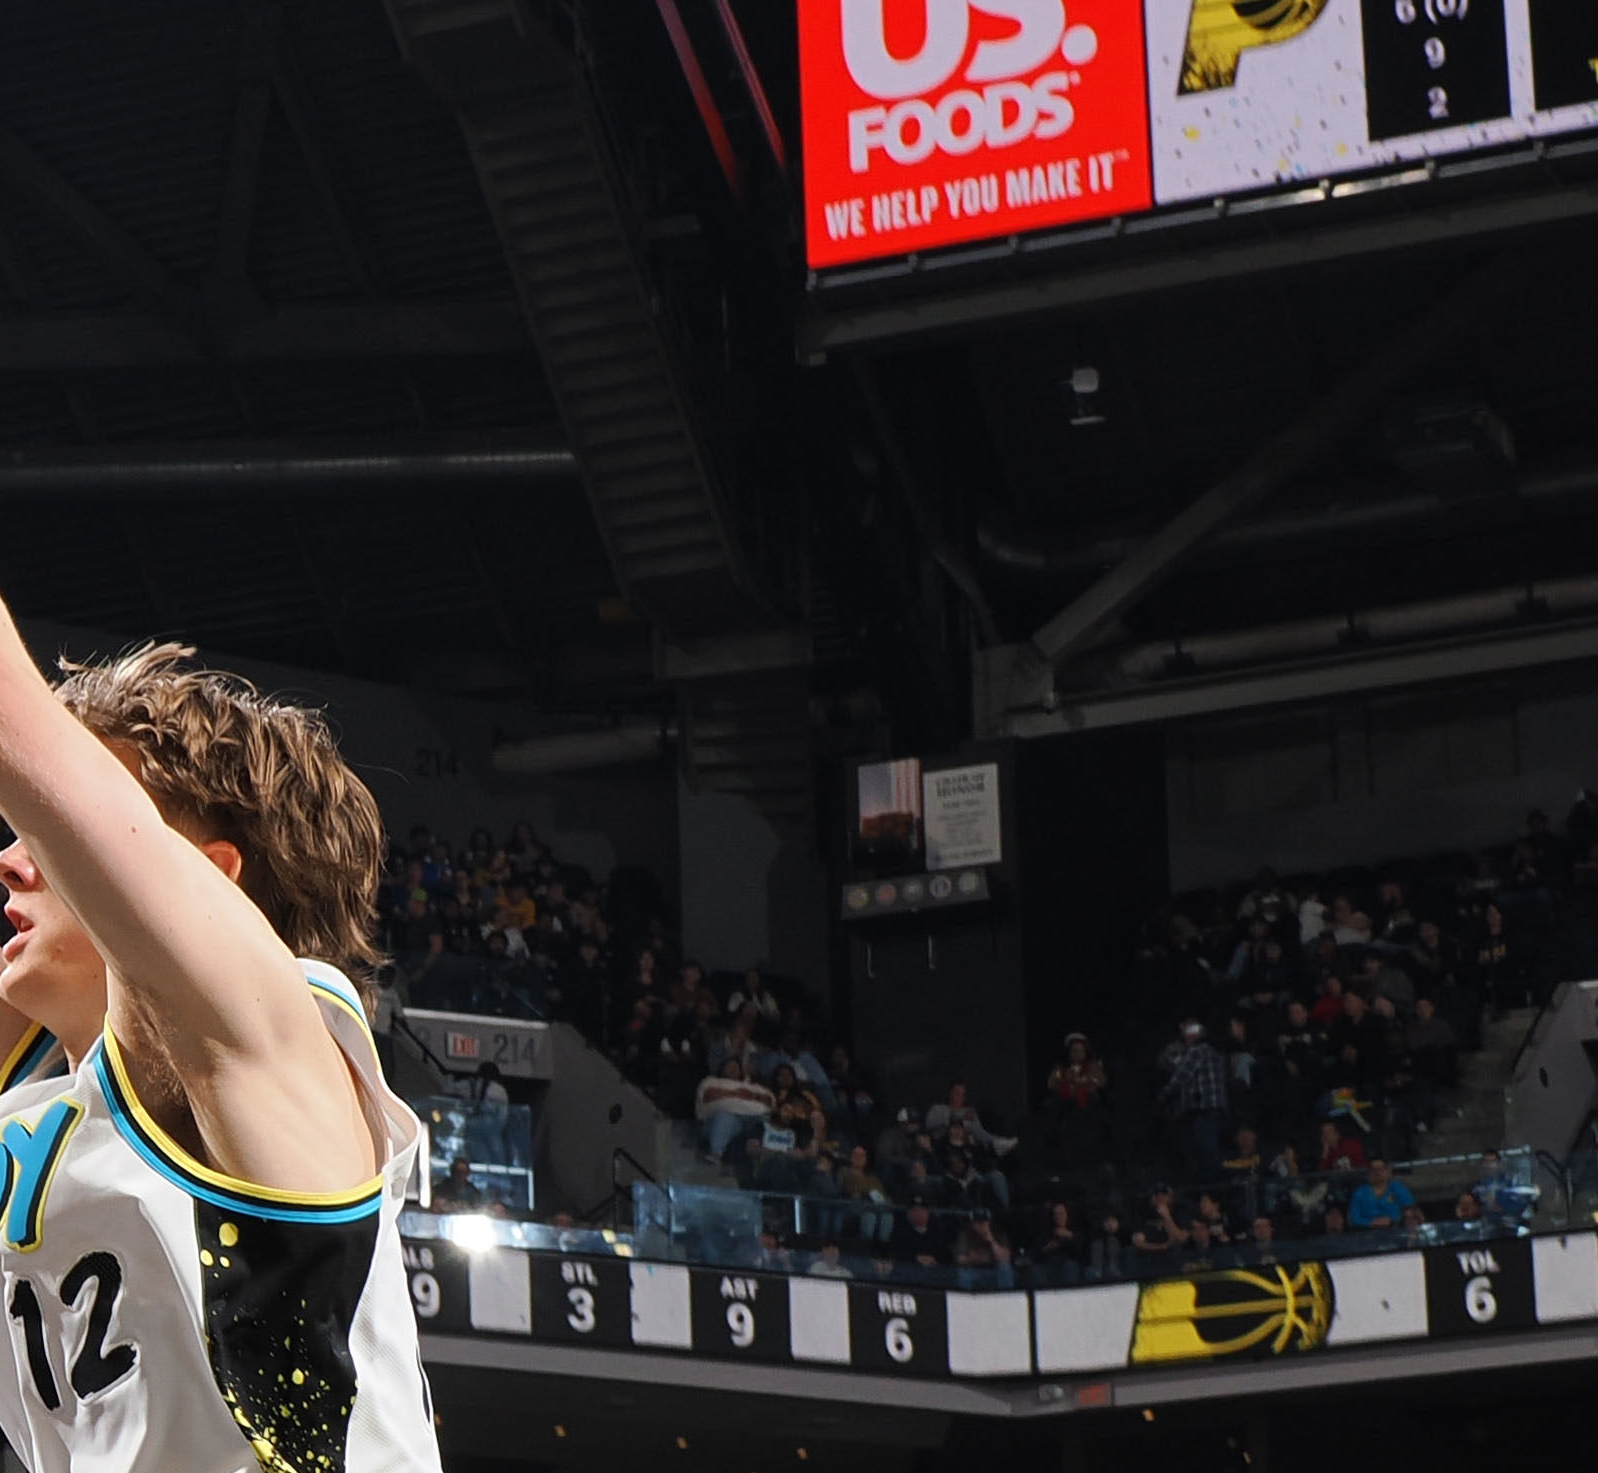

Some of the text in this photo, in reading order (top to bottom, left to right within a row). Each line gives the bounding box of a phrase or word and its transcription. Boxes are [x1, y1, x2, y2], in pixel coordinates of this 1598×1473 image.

[848, 71, 1076, 173] FOODS
[824, 153, 1115, 240] WE HELP YOU MAKE IT
[492, 1033, 536, 1069] 214
[1455, 1248, 1501, 1276] TOL
[411, 1271, 441, 1318] 9
[566, 1287, 596, 1333] 3
[720, 1275, 760, 1302] AST
[1465, 1275, 1498, 1325] 6
[9, 1250, 139, 1412] 12
[725, 1302, 756, 1348] 9
[885, 1317, 914, 1363] 6
